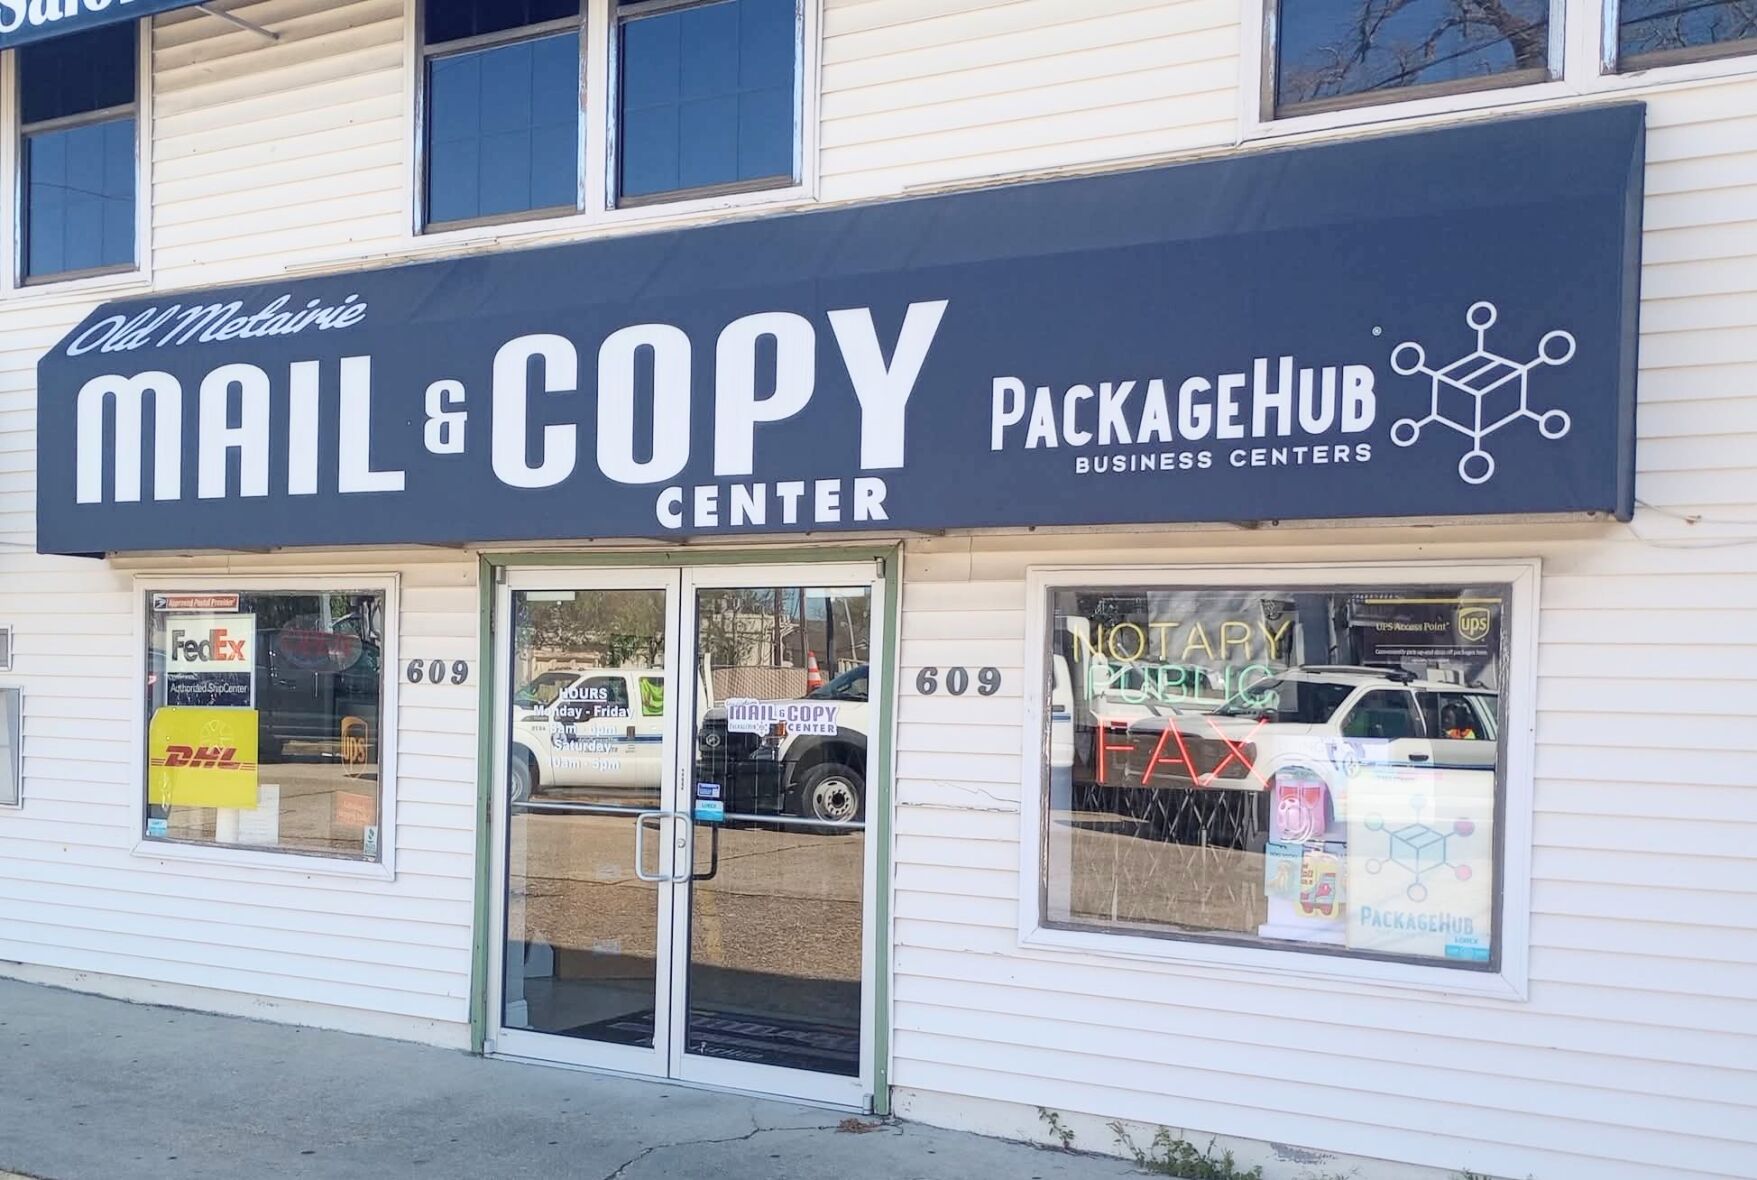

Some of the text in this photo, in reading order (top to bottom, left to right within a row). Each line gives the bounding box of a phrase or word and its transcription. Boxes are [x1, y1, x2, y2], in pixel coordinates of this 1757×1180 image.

[66, 294, 367, 356] Old Metairie
[76, 299, 949, 504] MAIL & COPY
[1075, 442, 1372, 474] BUSINESS CENTERS
[655, 476, 890, 529] CENTER
[1073, 619, 1291, 663] NOTARY
[1376, 621, 1394, 632] UPS
[1394, 621, 1423, 632] Access
[171, 628, 247, 662] FedEx
[407, 658, 469, 685] 609
[916, 666, 1001, 696] 609
[1086, 664, 1276, 706] PUBLIC
[170, 682, 247, 695] Authorized ShipCenter
[559, 687, 608, 700] HOURS
[533, 704, 583, 719] Monday
[593, 704, 634, 720] Friday
[729, 704, 777, 721] MAIL
[787, 705, 837, 722] COPY
[787, 722, 835, 733] CENTER
[164, 745, 241, 770] DHL
[1097, 716, 1270, 788] FAX
